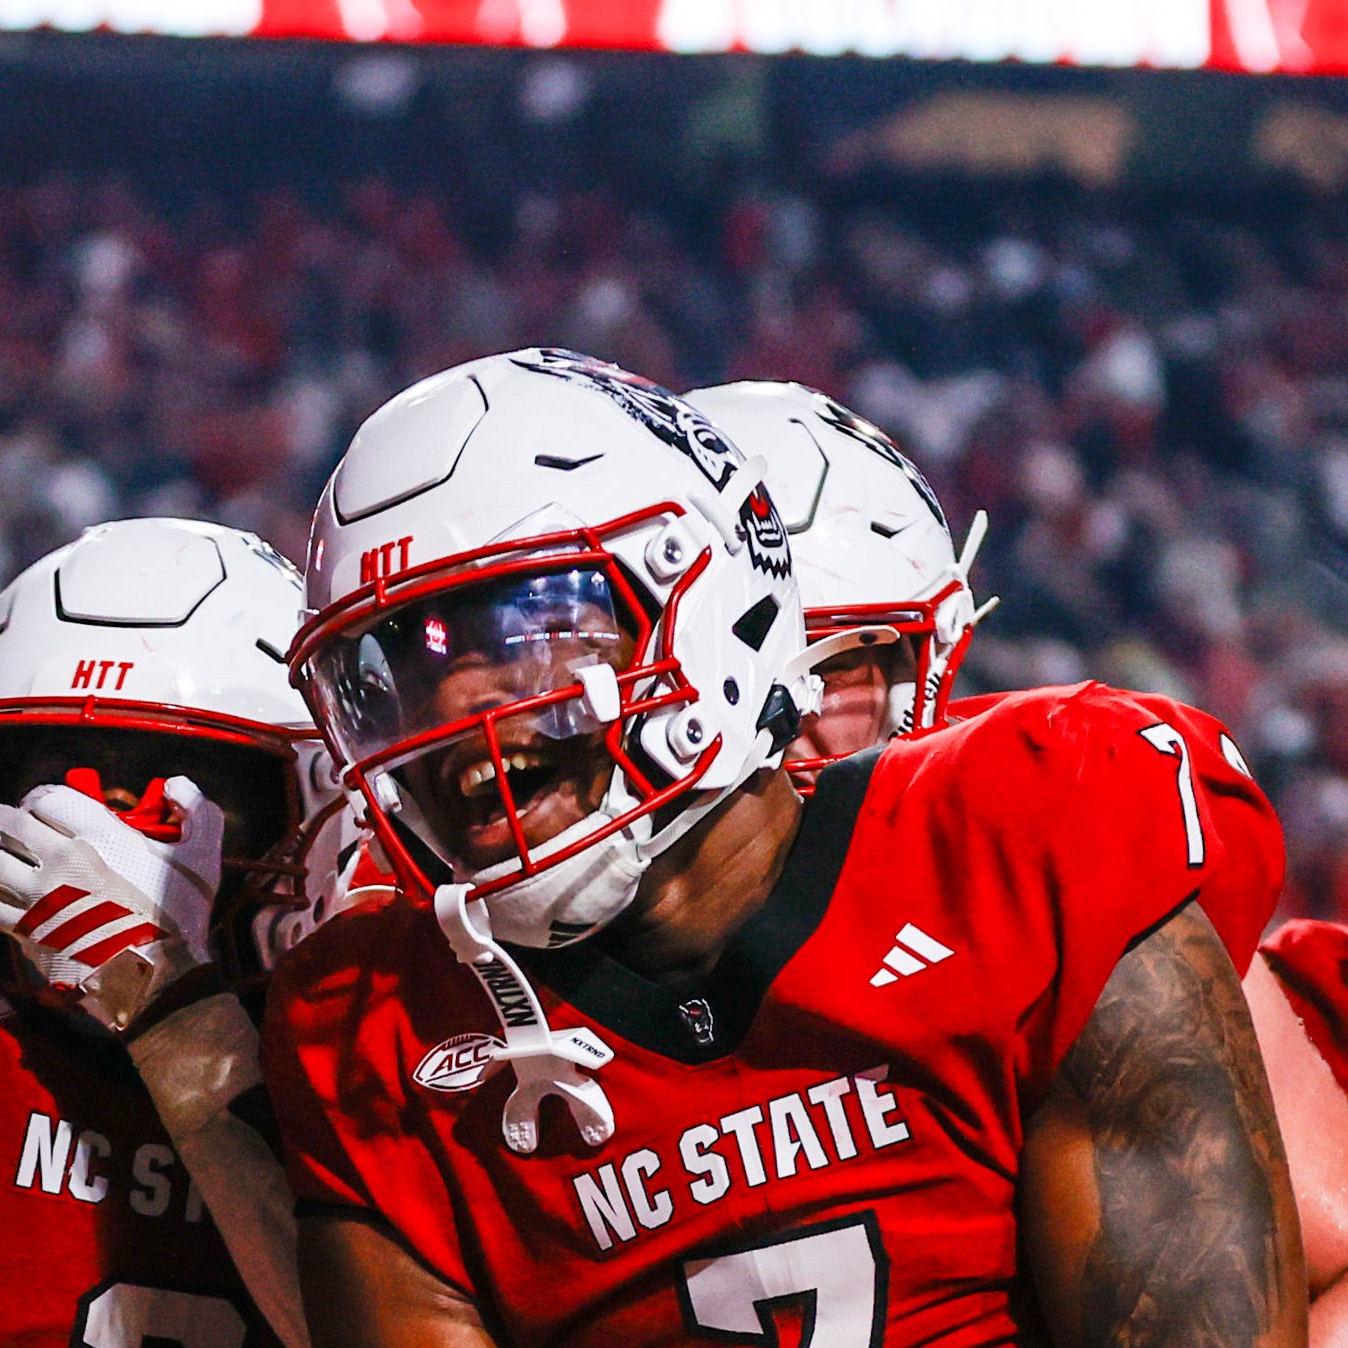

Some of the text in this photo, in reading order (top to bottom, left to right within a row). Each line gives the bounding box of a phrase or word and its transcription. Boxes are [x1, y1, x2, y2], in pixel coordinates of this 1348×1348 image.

[360, 536, 413, 584] HTT
[71, 659, 134, 691] HTT
[1136, 721, 1205, 870] 7
[431, 1041, 491, 1077] ACC
[569, 1036, 607, 1060] NXTRND
[14, 1111, 112, 1205] NC
[572, 1064, 911, 1252] NC STATE
